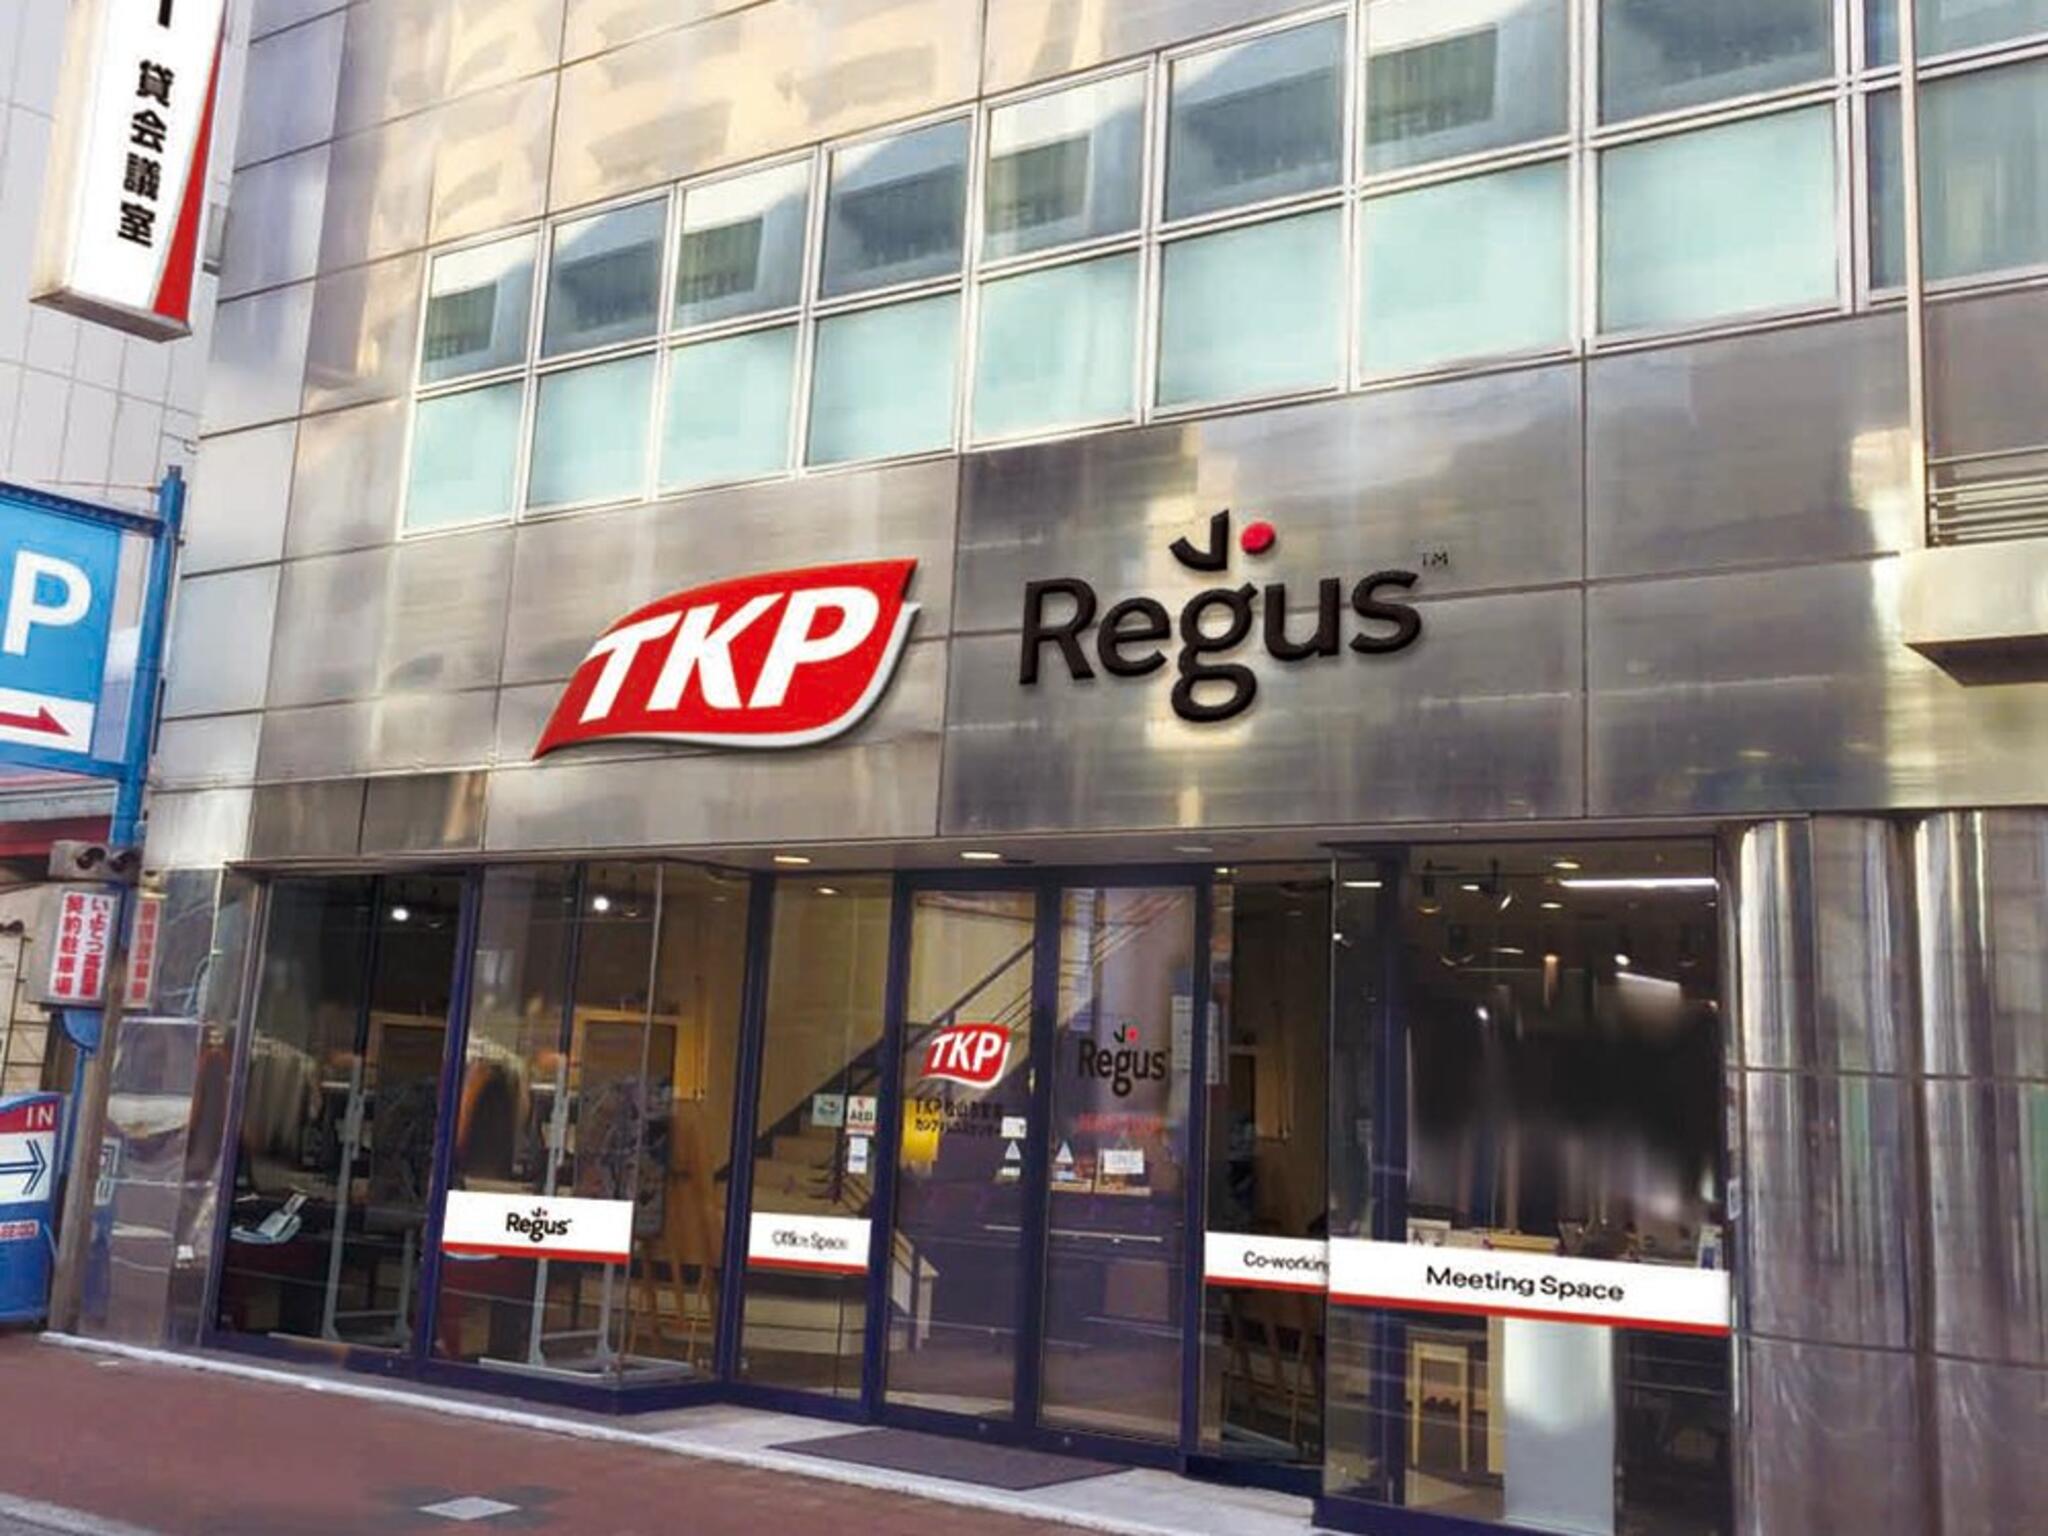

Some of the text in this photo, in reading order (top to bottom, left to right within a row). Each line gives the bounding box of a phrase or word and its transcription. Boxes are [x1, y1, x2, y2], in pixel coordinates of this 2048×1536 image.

[117, 59, 174, 248] 貸会議室
[4, 549, 92, 656] P
[578, 586, 881, 723] TKP
[1019, 568, 1423, 723] Regus
[931, 1031, 1002, 1073] TKP
[1079, 1038, 1166, 1098] Regus
[26, 1106, 54, 1128] IN
[506, 1212, 569, 1242] Regus
[1425, 1265, 1625, 1303] Meeting Space
